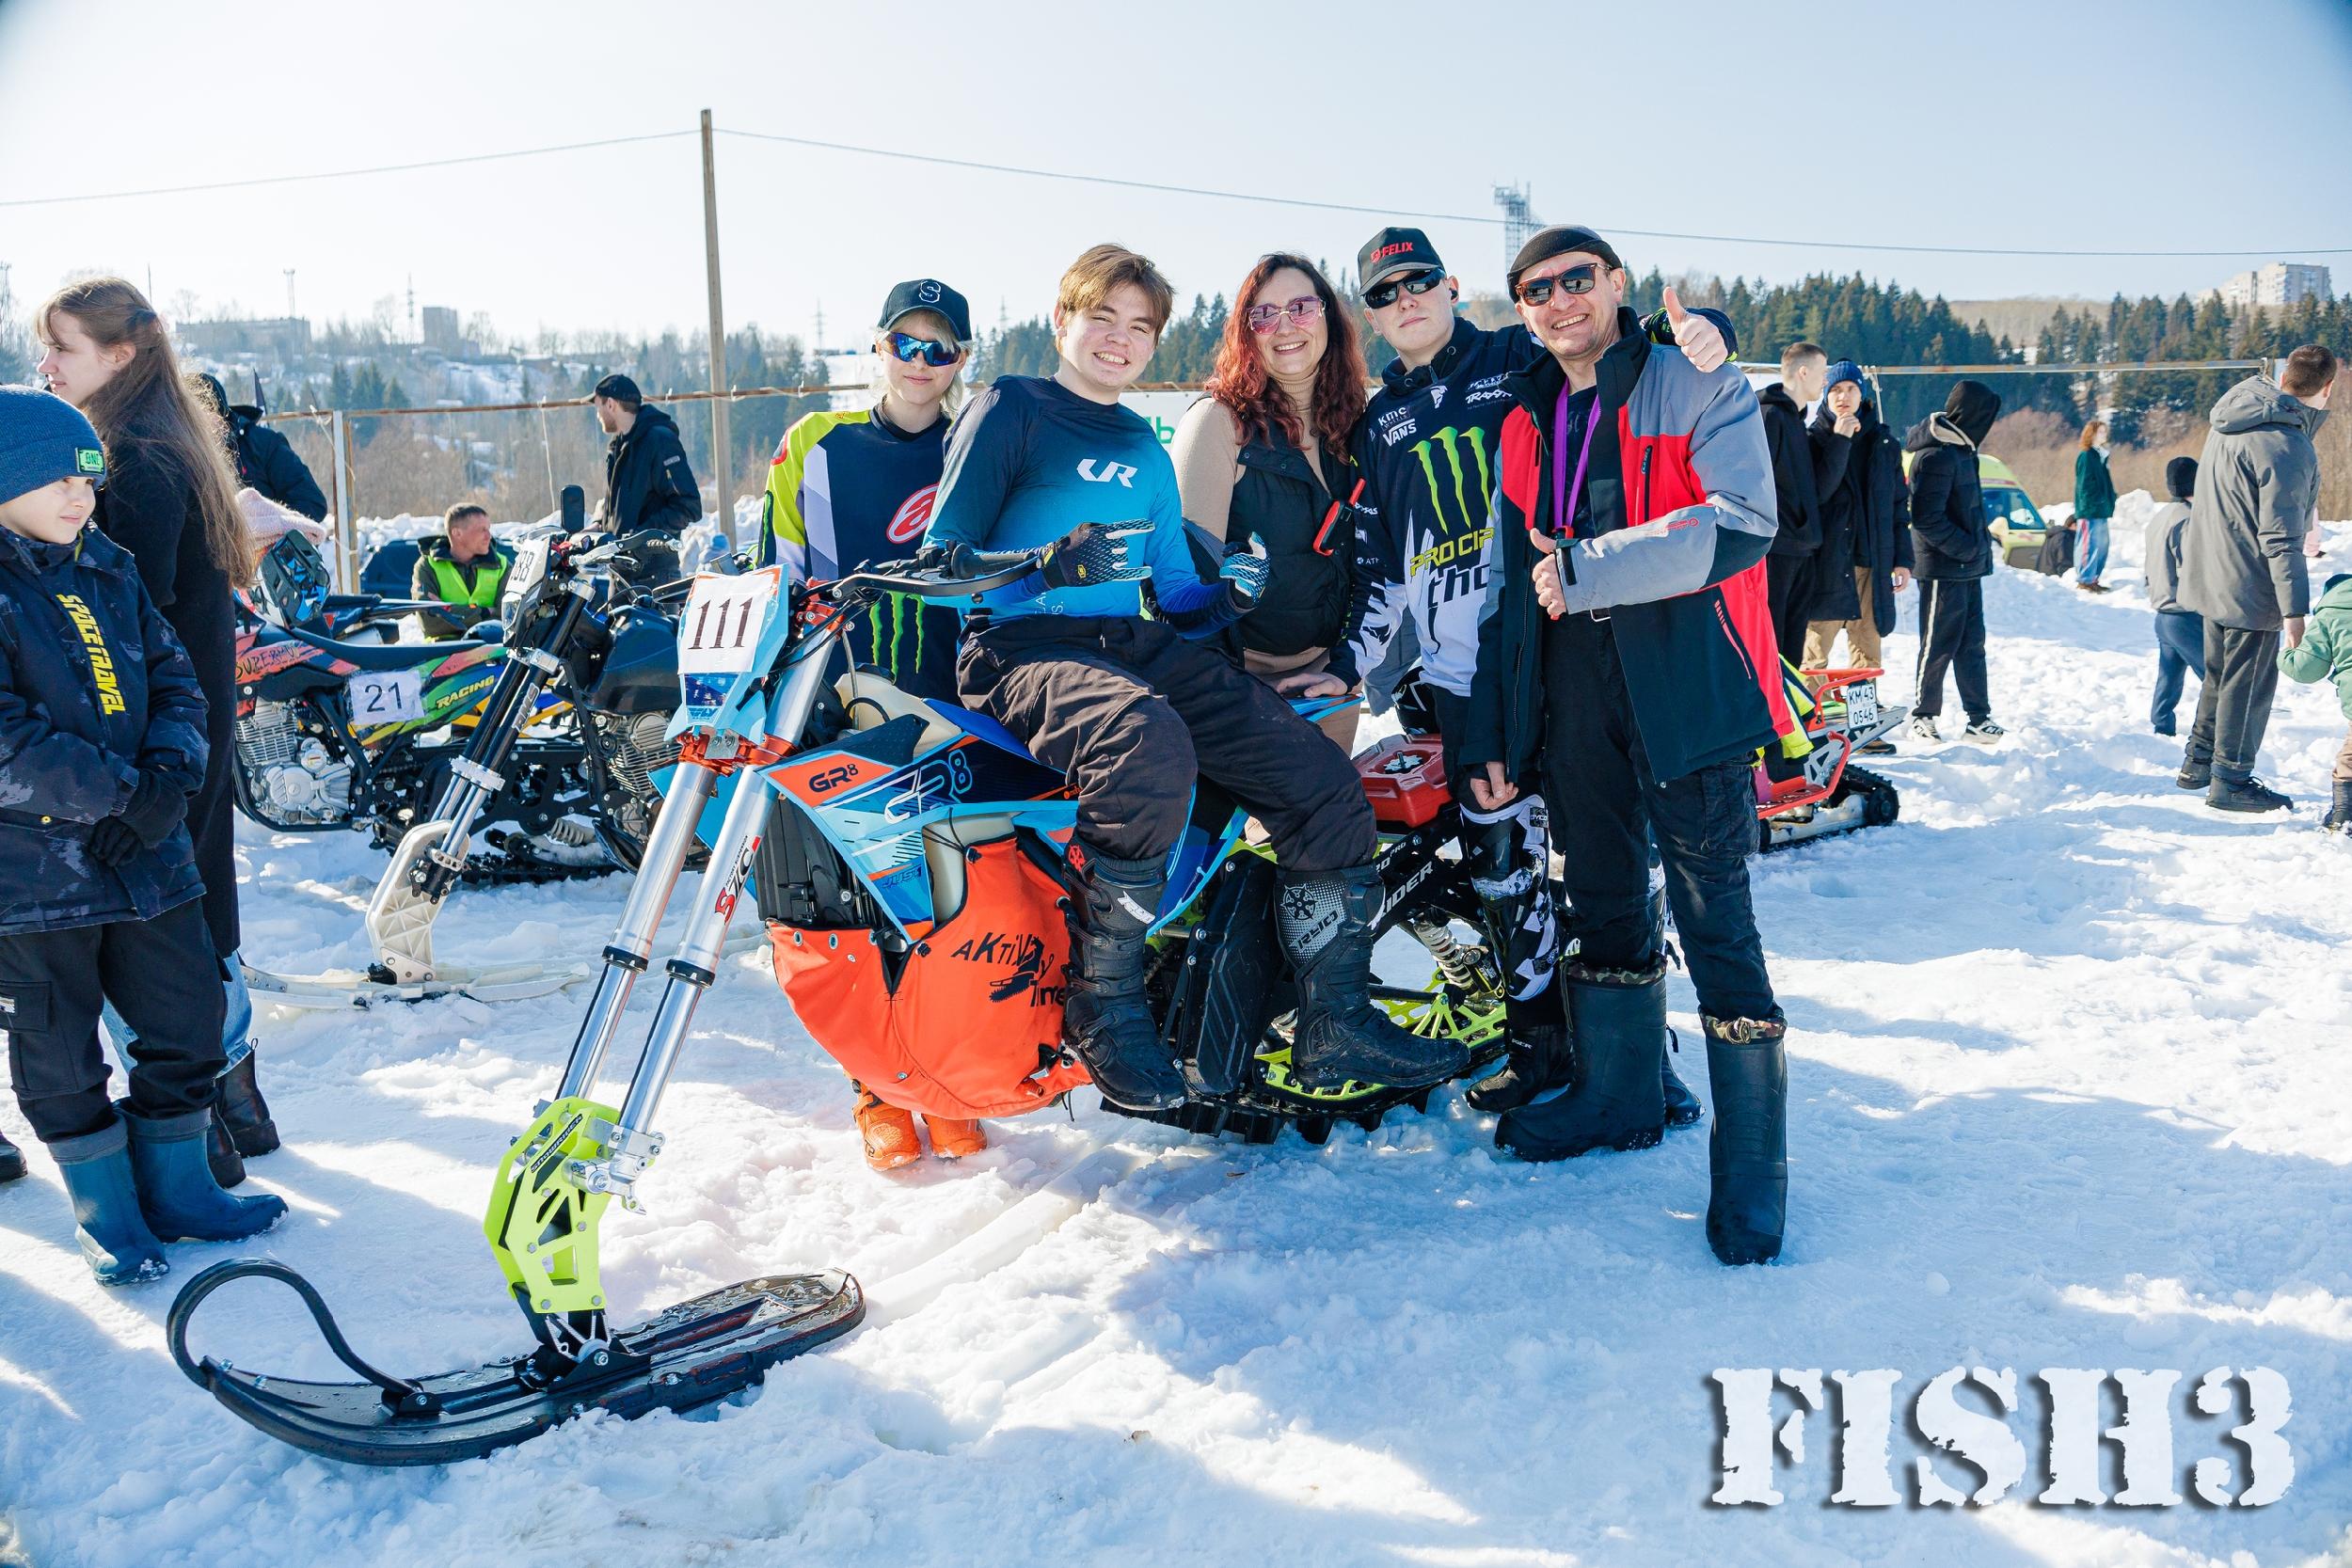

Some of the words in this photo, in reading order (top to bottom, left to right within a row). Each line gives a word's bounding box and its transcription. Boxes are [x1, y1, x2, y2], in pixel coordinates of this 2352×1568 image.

[1382, 242, 1413, 257] FELIX
[1382, 418, 1417, 447] VANS
[1410, 540, 1455, 577] PRO
[687, 596, 754, 650] 111
[56, 594, 103, 649] SPACE
[87, 644, 126, 715] TRAVEL
[364, 681, 404, 713] 21
[436, 674, 495, 709] RACING
[1864, 687, 1874, 701] 43
[1853, 708, 1874, 725] 0546
[808, 763, 859, 793] GR8
[1390, 842, 1406, 857] PRO
[1381, 861, 1433, 918] IDER
